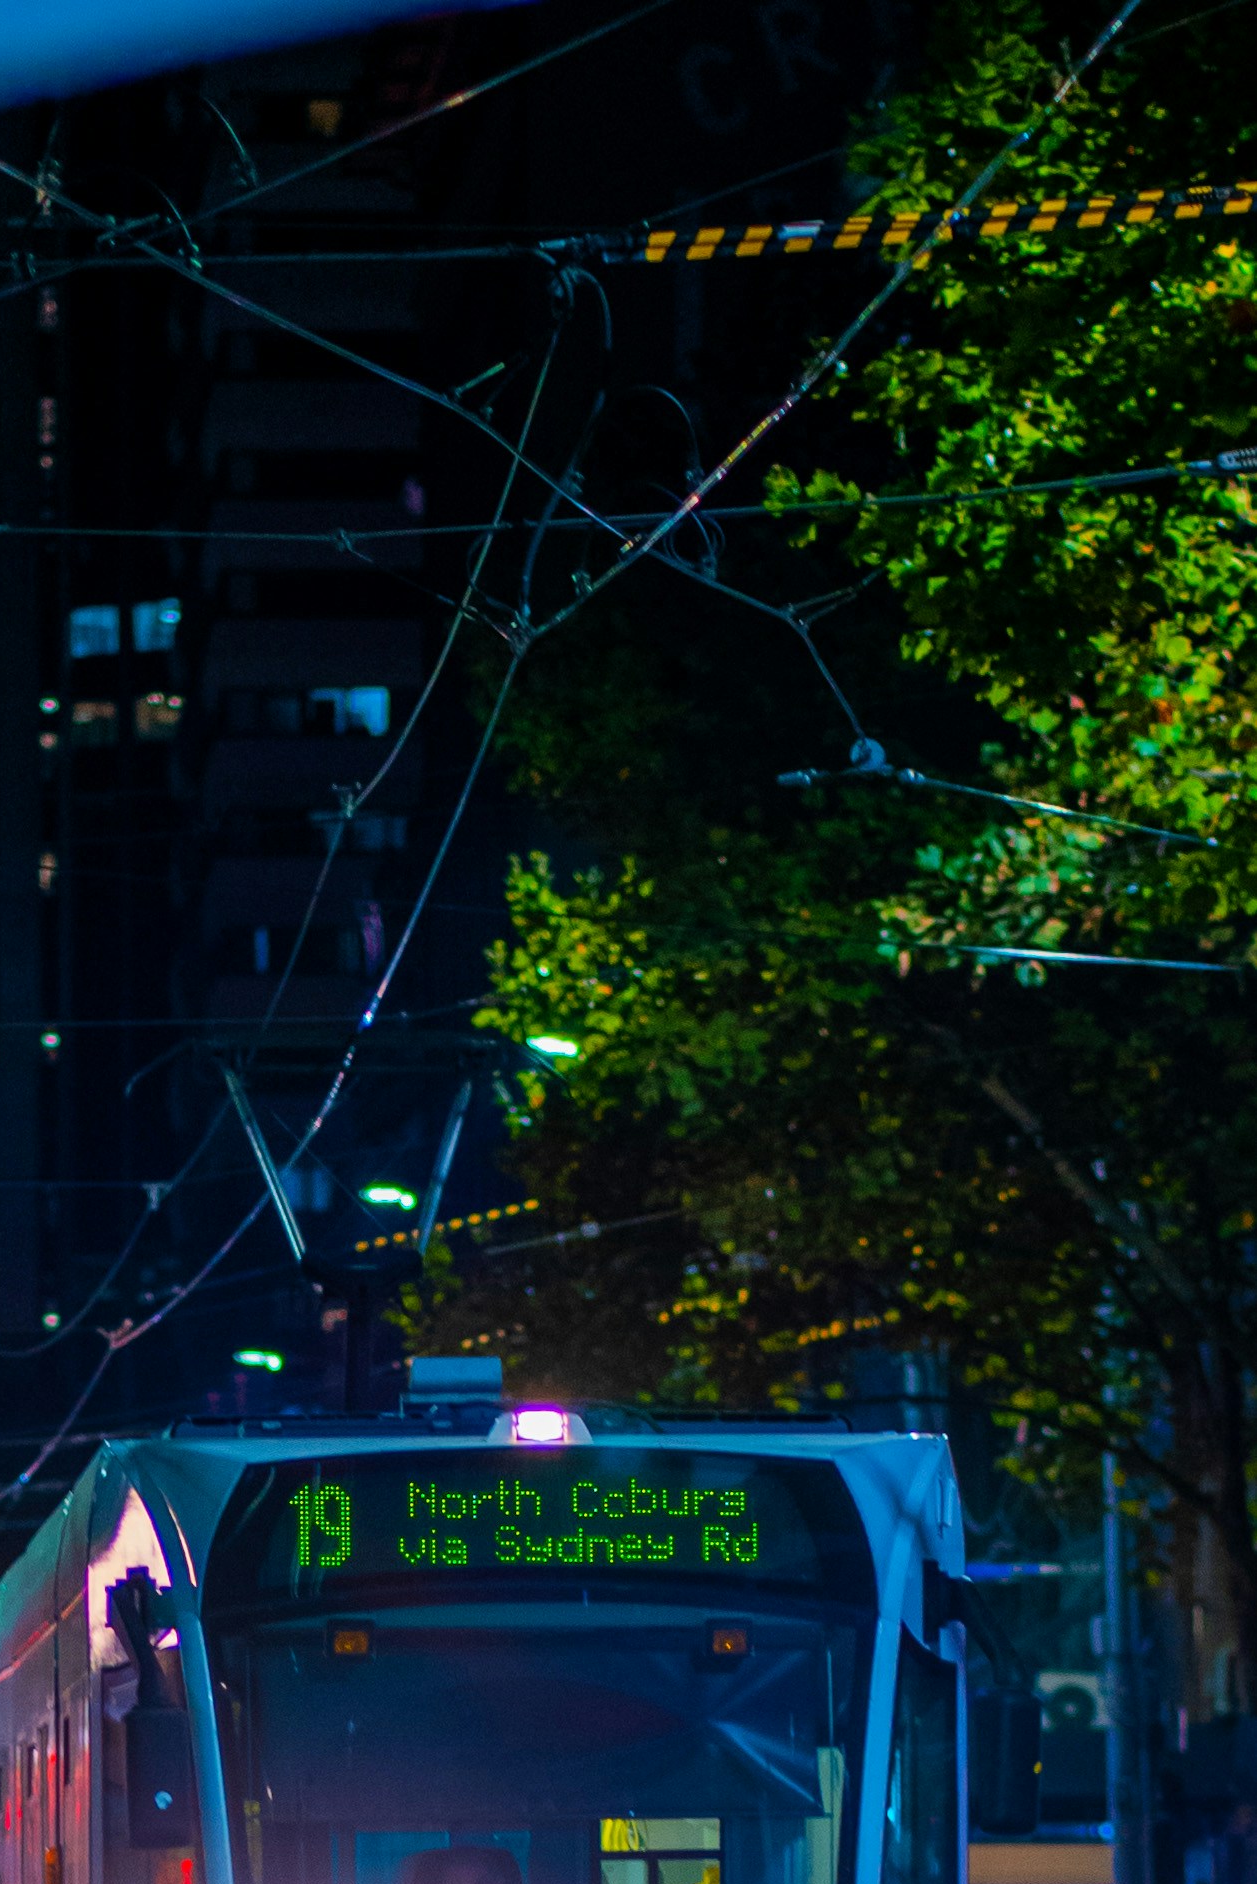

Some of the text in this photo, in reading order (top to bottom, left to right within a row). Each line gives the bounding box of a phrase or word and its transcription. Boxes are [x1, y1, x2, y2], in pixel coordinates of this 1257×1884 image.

[408, 1479, 542, 1519] North
[290, 1484, 351, 1566] 19
[400, 1521, 758, 1565] via Sydney Rd
